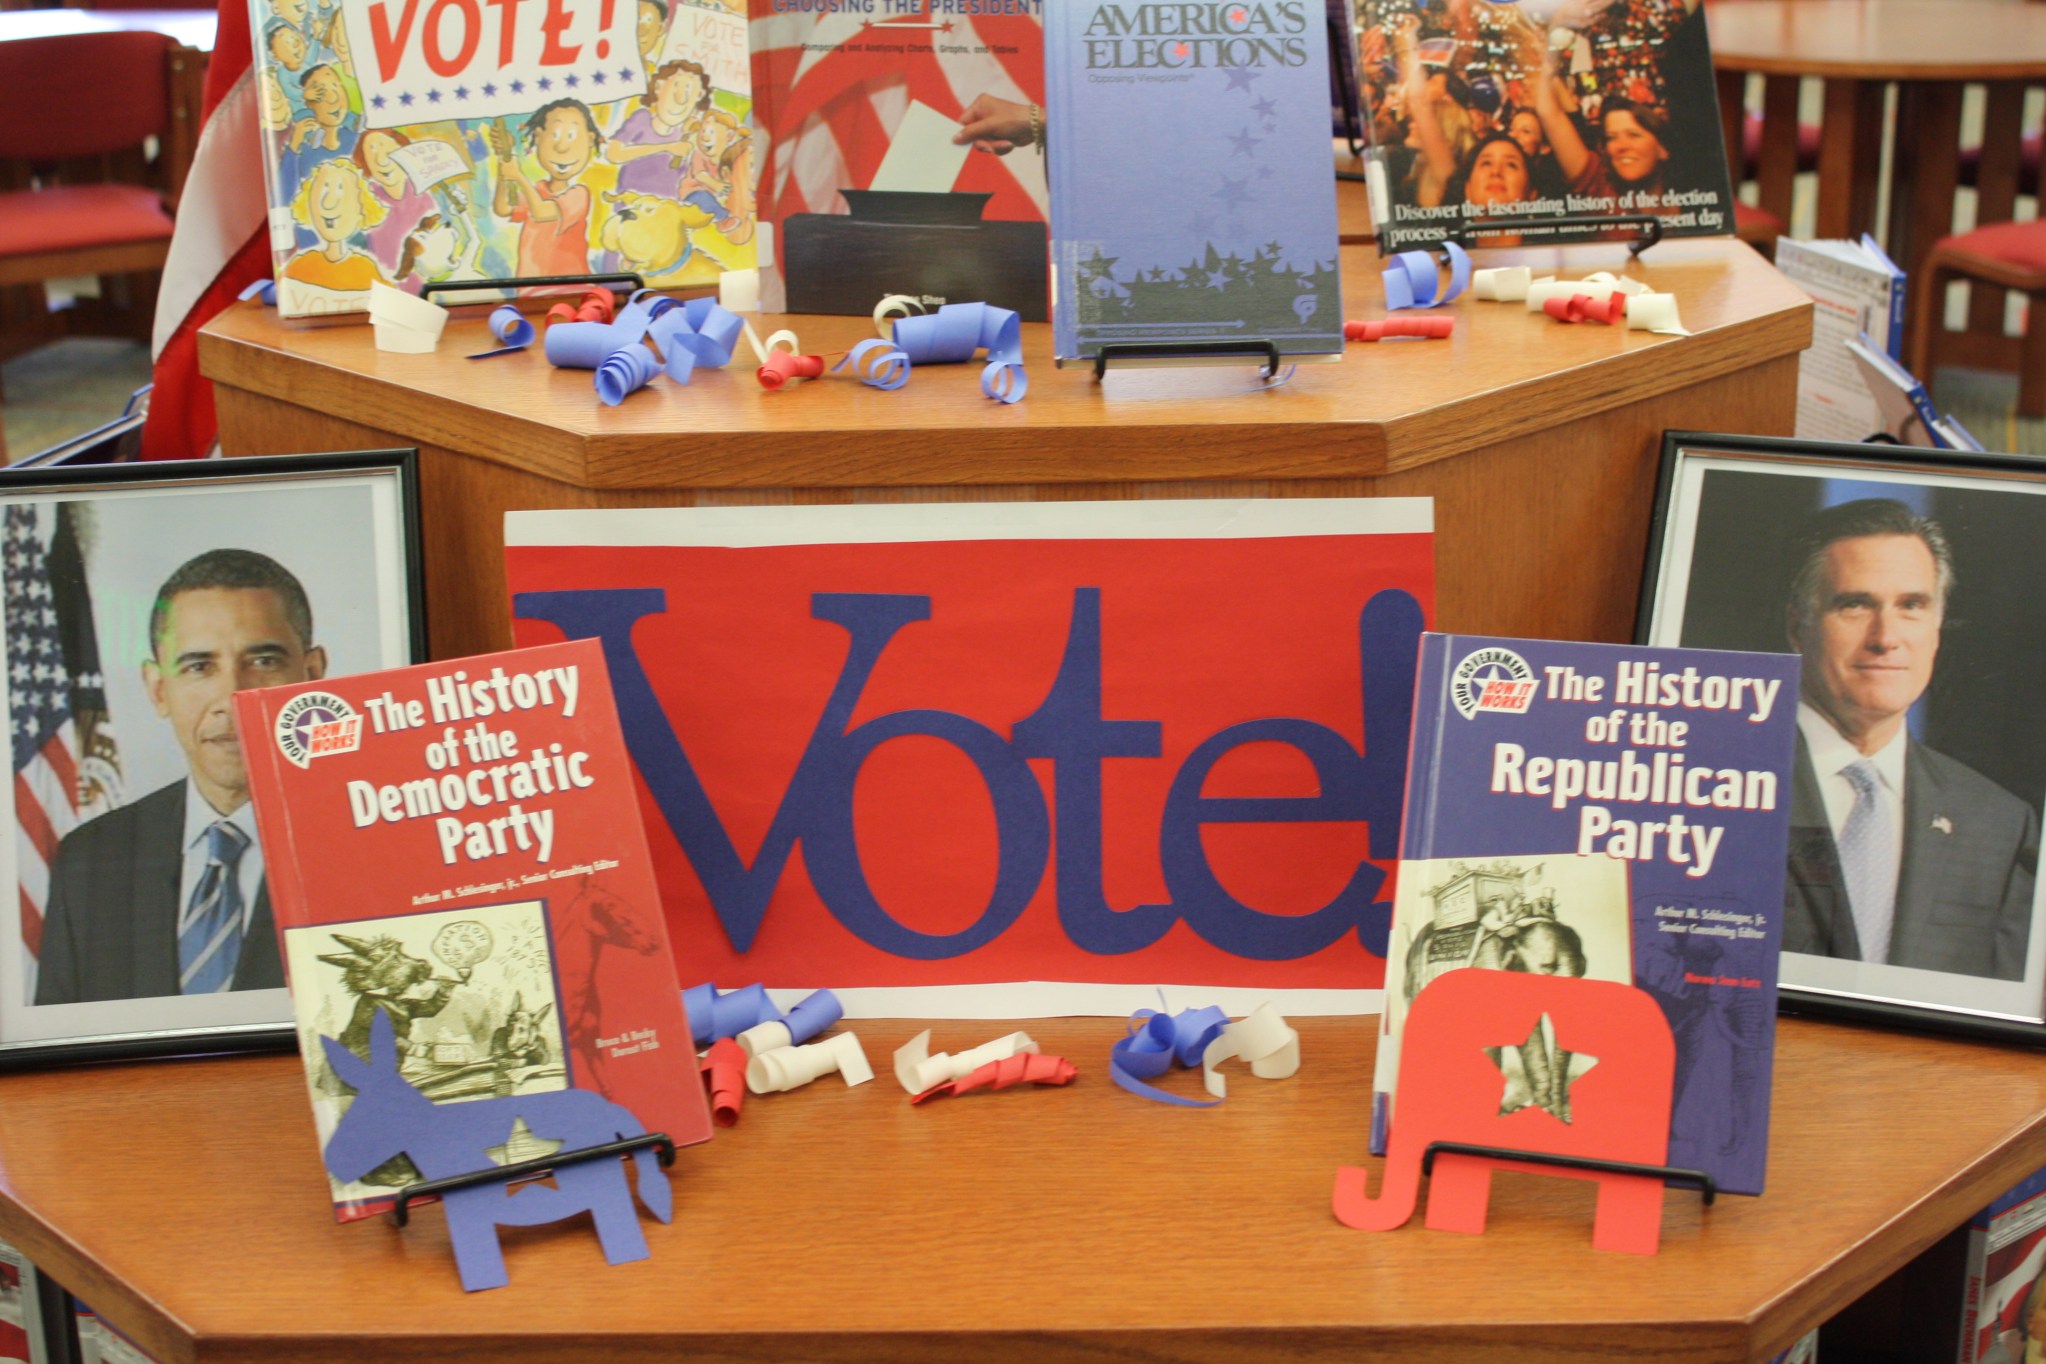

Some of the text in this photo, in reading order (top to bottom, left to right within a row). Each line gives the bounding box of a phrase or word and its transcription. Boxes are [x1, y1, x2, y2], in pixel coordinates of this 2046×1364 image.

[772, 0, 1043, 15] CHOOSING THE PRESIDENT
[1083, 2, 1308, 36] AMERICA'S
[368, 0, 618, 83] VOTE!
[801, 42, 845, 53] Comparing
[848, 44, 862, 53] and
[865, 44, 905, 54] Analyzing
[974, 46, 989, 54] and
[992, 45, 1019, 54] Tables
[1083, 38, 1308, 69] ELECTIONS
[1087, 73, 1135, 84] Opposing
[1390, 226, 1448, 248] process
[1697, 208, 1724, 230] day
[1395, 188, 1718, 221] Discover the fascinating history of the election
[364, 665, 580, 734] The History
[1456, 651, 1528, 713] YOUR GOVERNMENT
[1480, 695, 1526, 709] WORKS
[1485, 681, 1532, 695] HOW IT
[1544, 660, 1783, 723] The History
[280, 696, 350, 763] YOUR GOVERNMENT
[425, 722, 520, 771] of the
[1585, 709, 1690, 748] of the
[346, 743, 595, 828] Democratic
[512, 586, 1425, 961] Vote!
[1490, 742, 1778, 811] Republican
[435, 804, 554, 865] Party
[1577, 805, 1725, 879] Party
